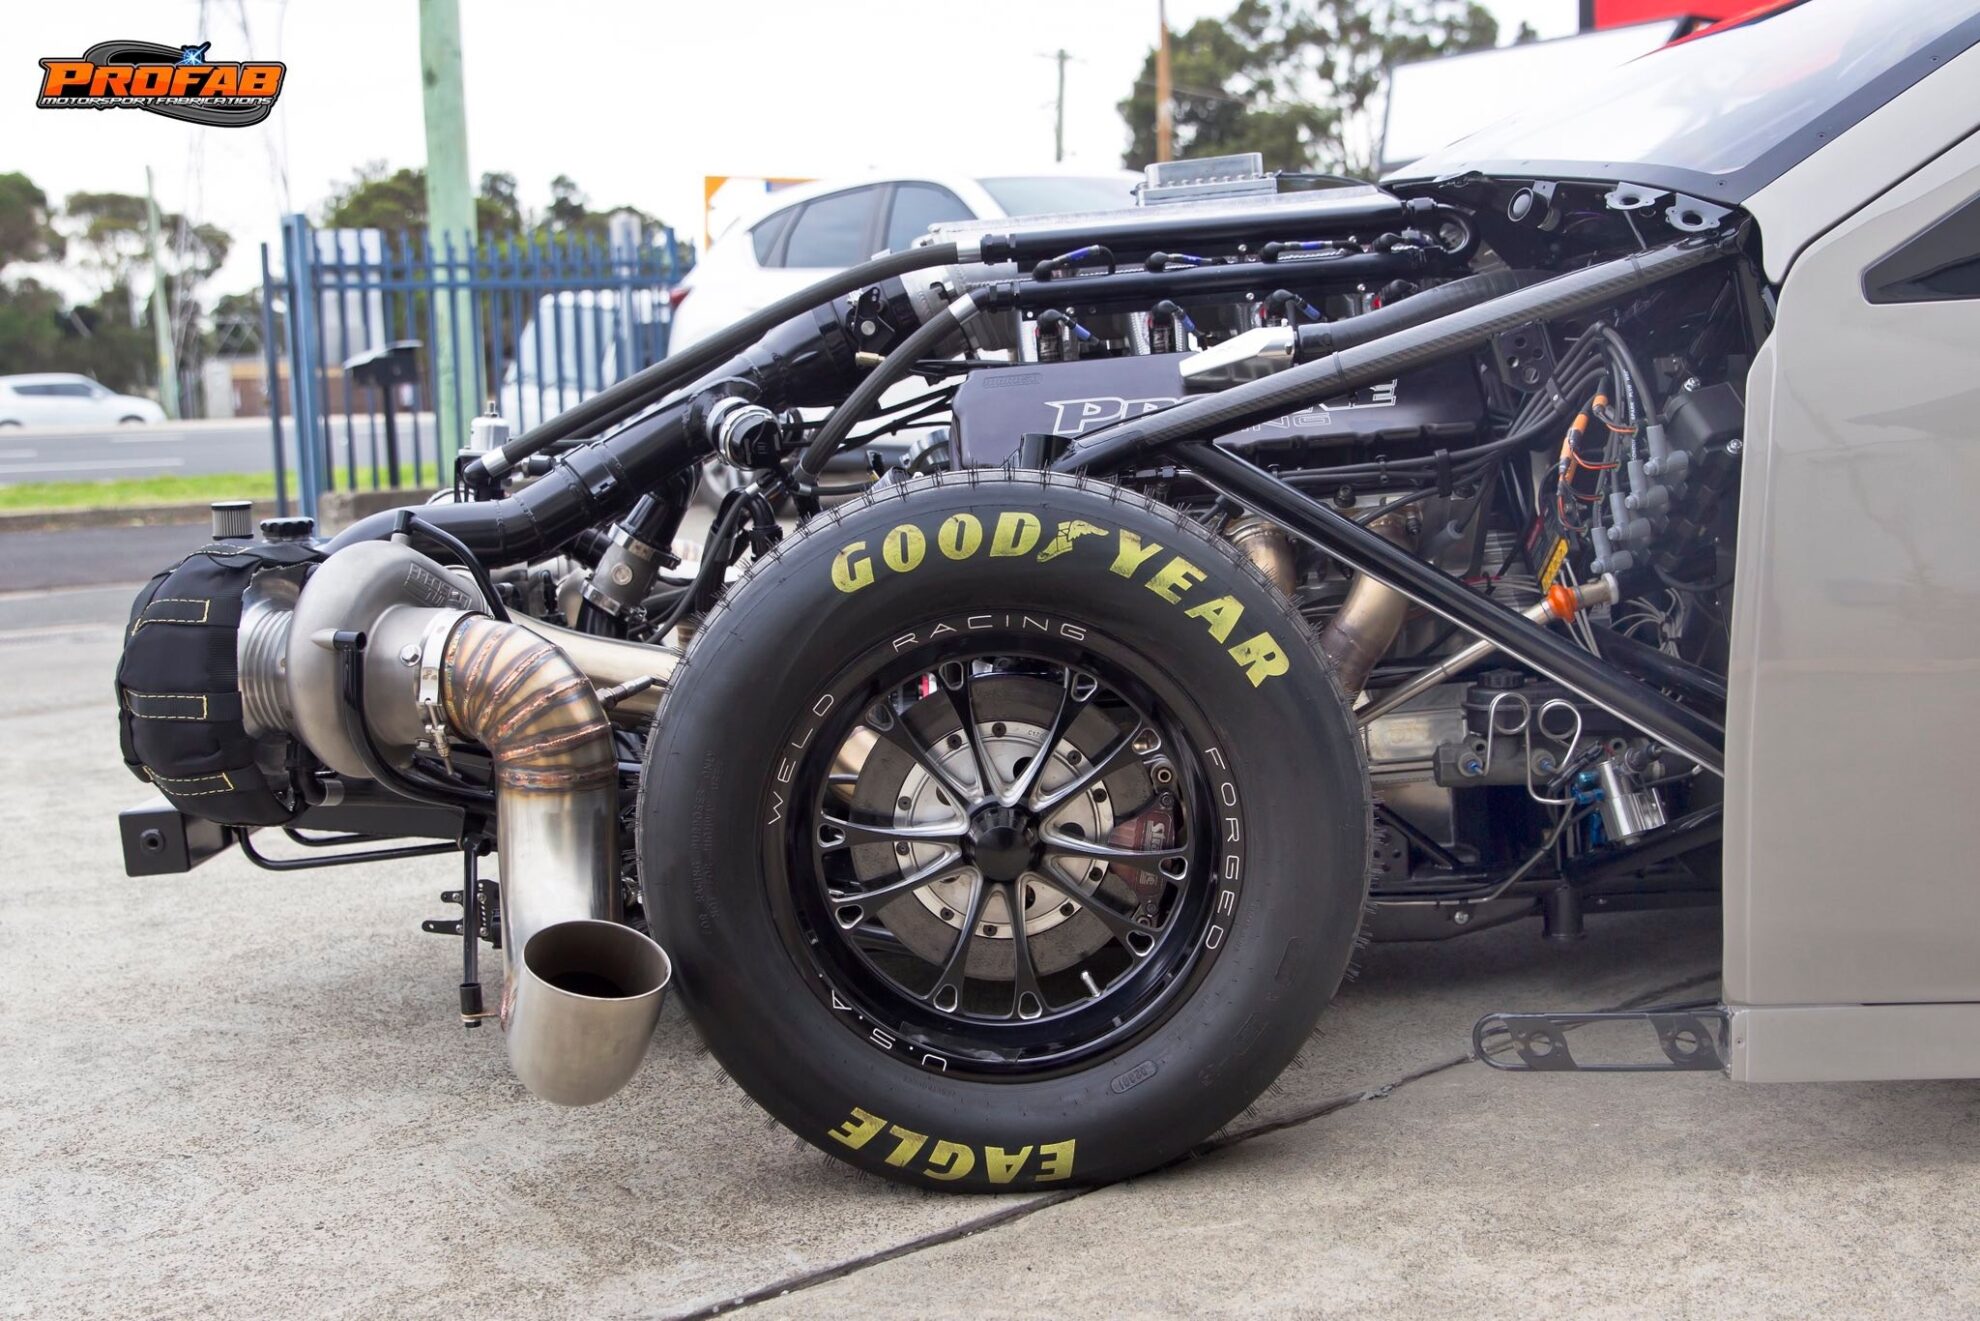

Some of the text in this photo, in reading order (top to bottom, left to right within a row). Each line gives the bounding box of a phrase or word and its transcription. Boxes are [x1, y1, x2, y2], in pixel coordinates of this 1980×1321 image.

[893, 613, 1089, 654] RACING
[768, 692, 835, 826] WELD
[1205, 746, 1241, 950] FORGED
[828, 1106, 1077, 1185] EAGLE
